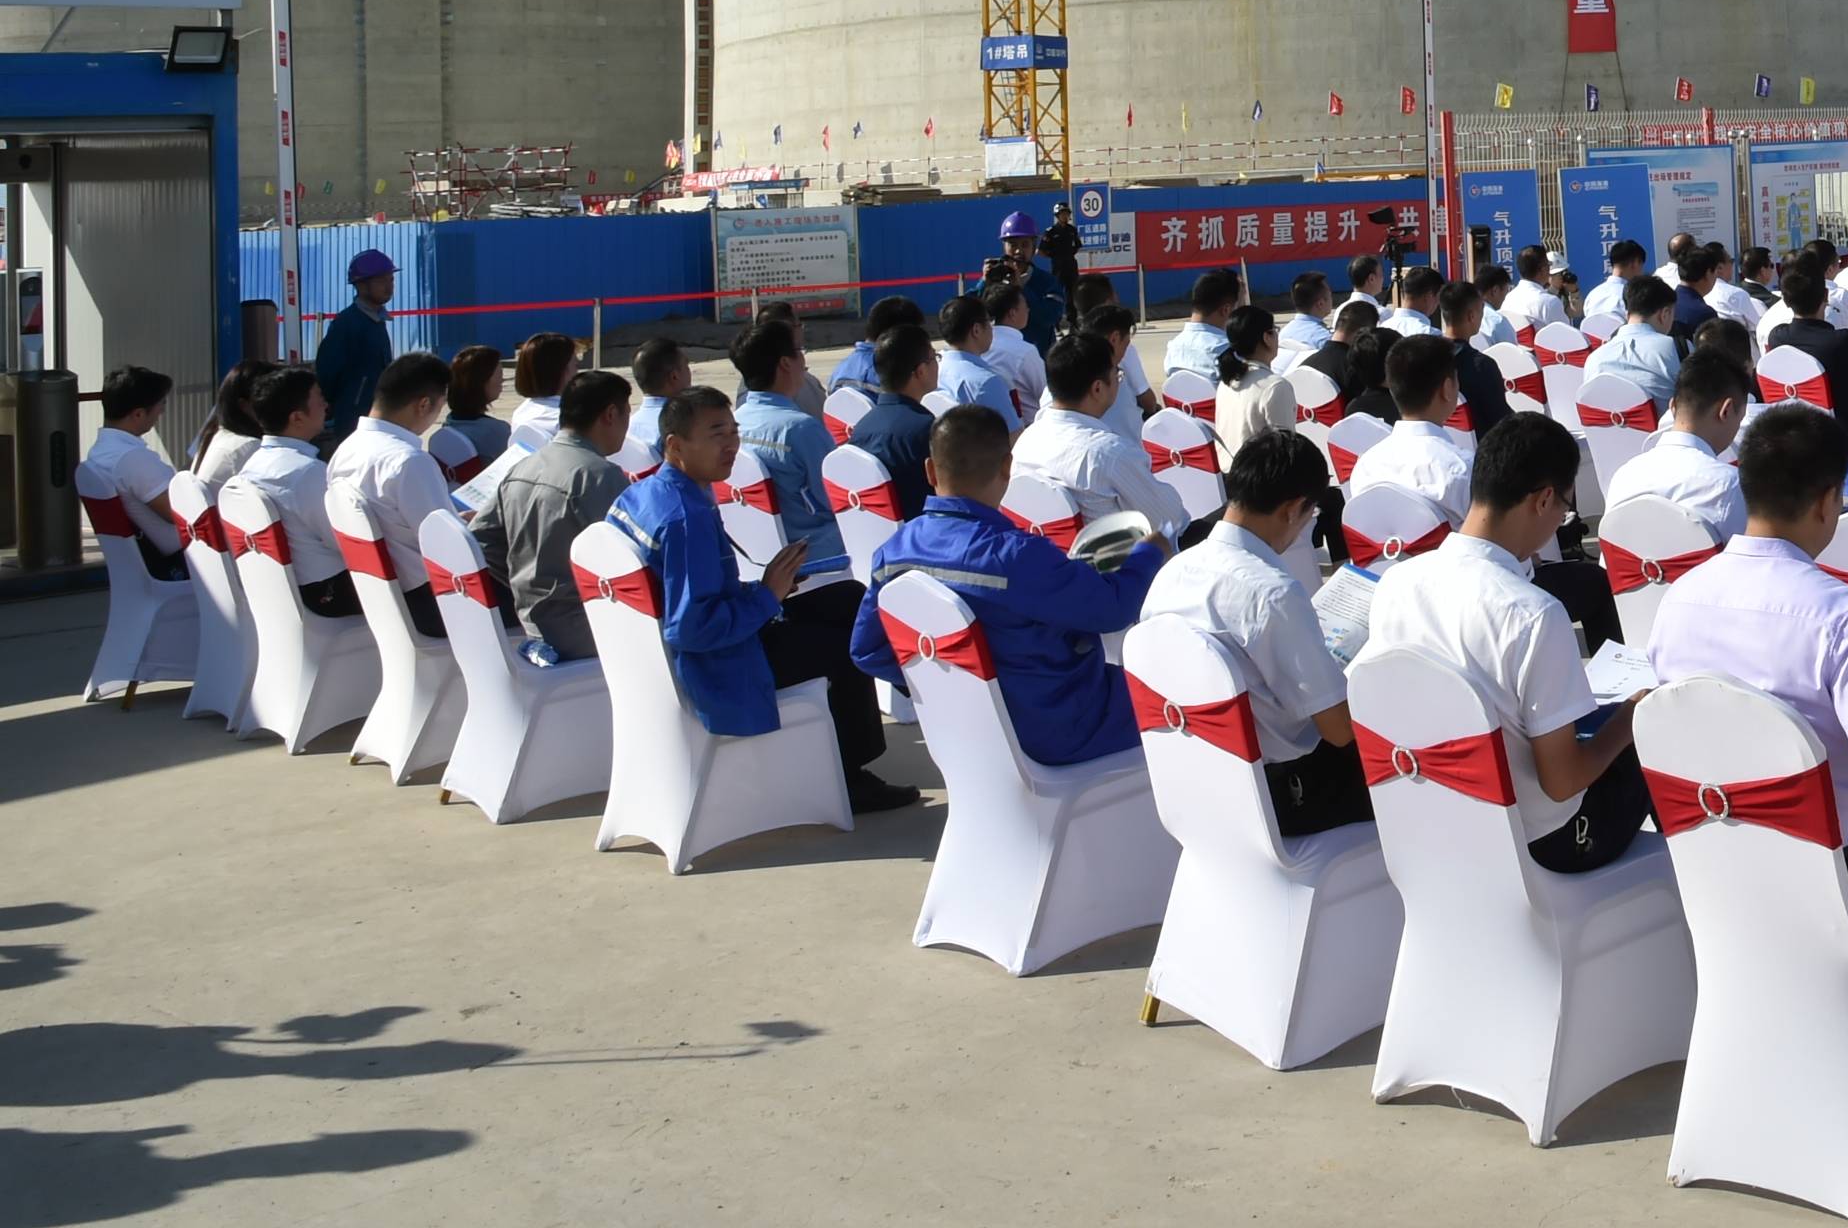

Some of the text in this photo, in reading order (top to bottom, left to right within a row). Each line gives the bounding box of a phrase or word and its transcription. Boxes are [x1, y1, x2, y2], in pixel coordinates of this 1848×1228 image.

[986, 43, 1028, 61] 1#塔吊
[1083, 197, 1099, 212] 30
[1161, 209, 1360, 253] 齐抓质量提升
